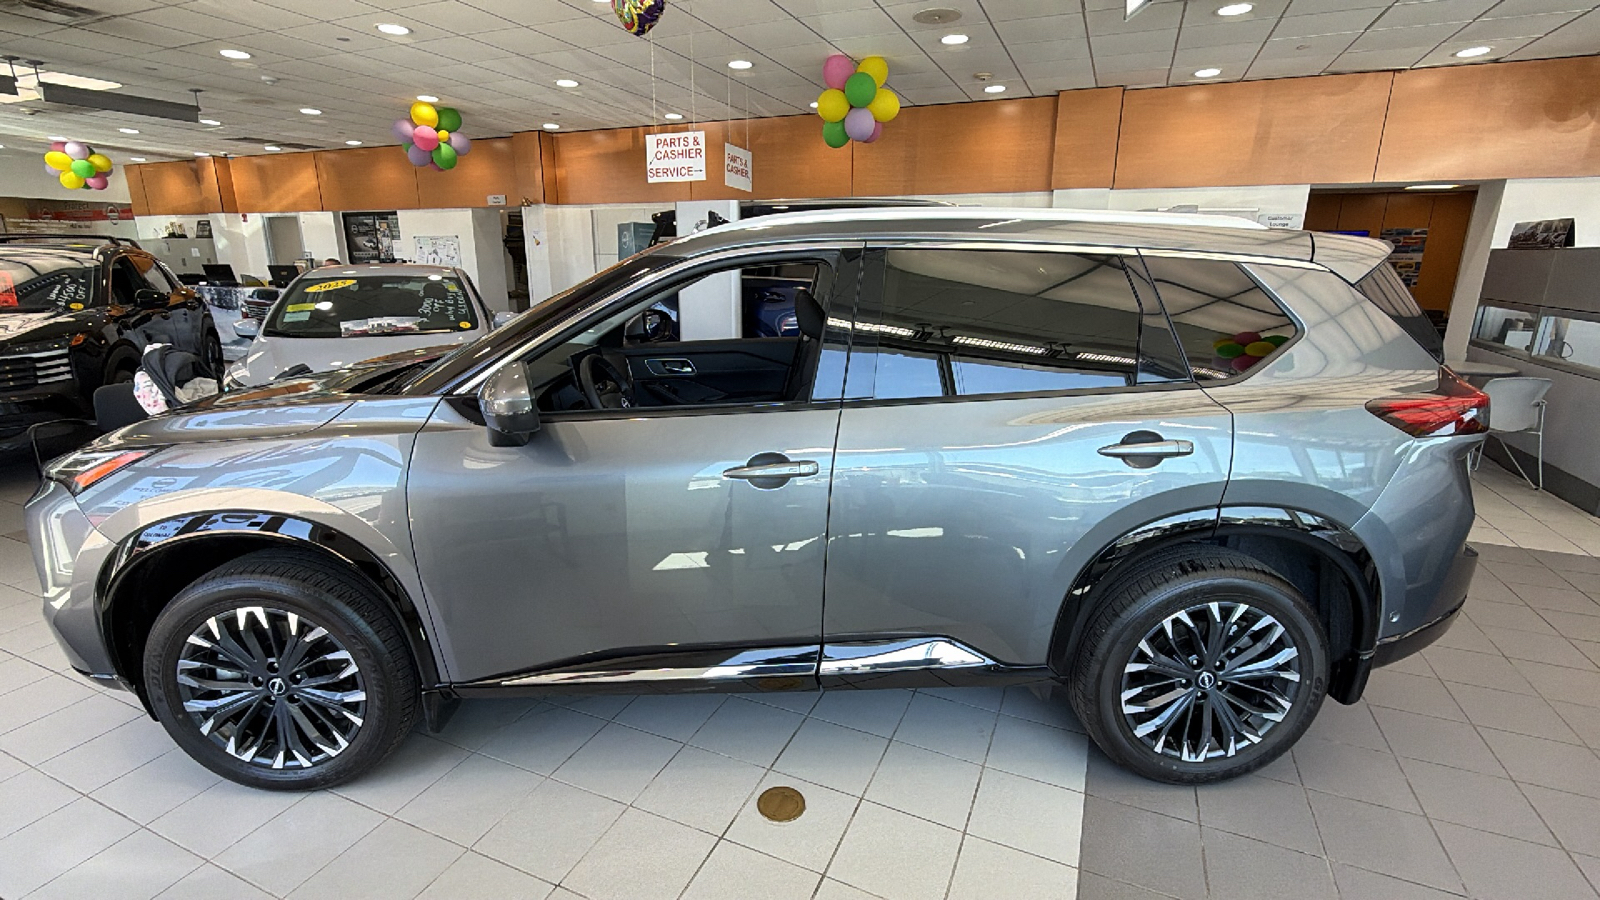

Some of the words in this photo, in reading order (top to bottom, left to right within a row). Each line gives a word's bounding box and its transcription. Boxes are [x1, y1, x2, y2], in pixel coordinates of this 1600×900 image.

[656, 137, 689, 148] PARTS
[693, 136, 700, 147] &
[655, 148, 702, 160] CASHIER
[727, 153, 743, 166] PARTS
[648, 166, 694, 178] SERVICE
[726, 164, 749, 178] CASHIER
